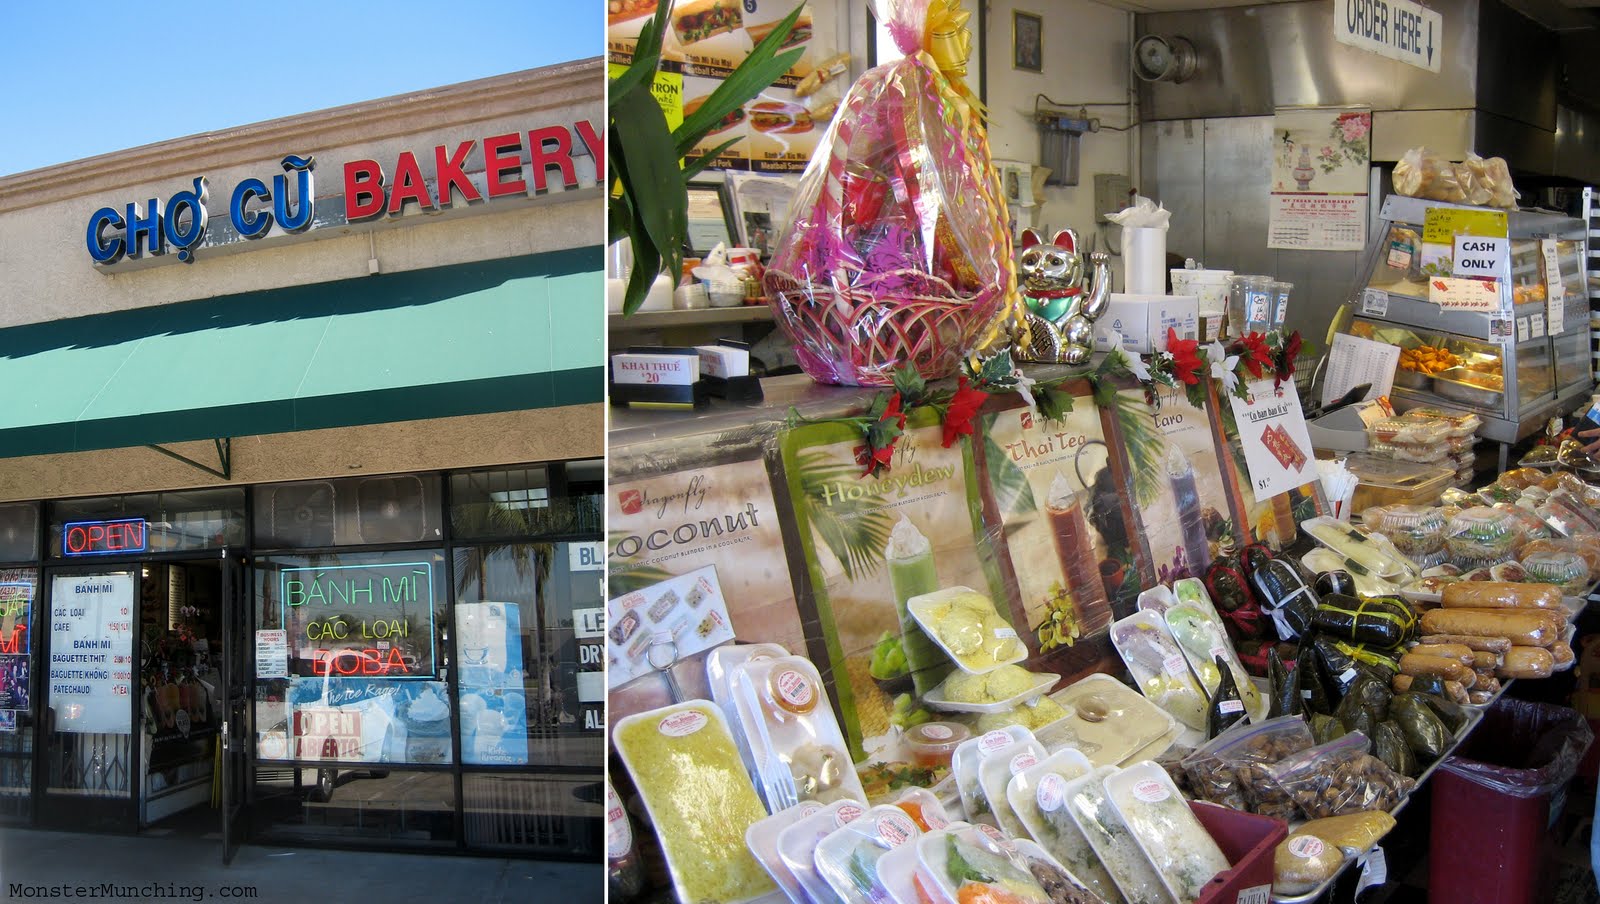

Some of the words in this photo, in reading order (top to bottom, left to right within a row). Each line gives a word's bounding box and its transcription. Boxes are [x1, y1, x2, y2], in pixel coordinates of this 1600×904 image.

[1346, 0, 1388, 44] ORDER
[1393, 6, 1422, 55] HERE
[87, 175, 209, 264] CHỢ
[229, 154, 317, 240] CŨ
[343, 119, 604, 221] BAKERY
[1462, 241, 1496, 252] CASH
[1461, 258, 1497, 269] ONLY
[621, 361, 649, 371] KHAI
[1149, 413, 1183, 429] Taro
[1005, 436, 1054, 462] Thai
[1055, 432, 1088, 450] Tea
[639, 475, 706, 519] dragonfly
[821, 463, 956, 507] Honeydew
[67, 523, 143, 552] OPEN
[608, 502, 759, 559] oconut
[579, 547, 604, 566] BL
[286, 572, 373, 607] BÁNH
[382, 569, 427, 603] MÌ
[306, 615, 349, 640] CÁC
[53, 654, 88, 663] BAGUETTE
[312, 648, 409, 675] BOBA
[51, 670, 83, 679] BAGUETTE
[53, 685, 91, 694] PATECHAUD
[299, 711, 354, 737] OPEN
[295, 737, 360, 758] ABIERTO
